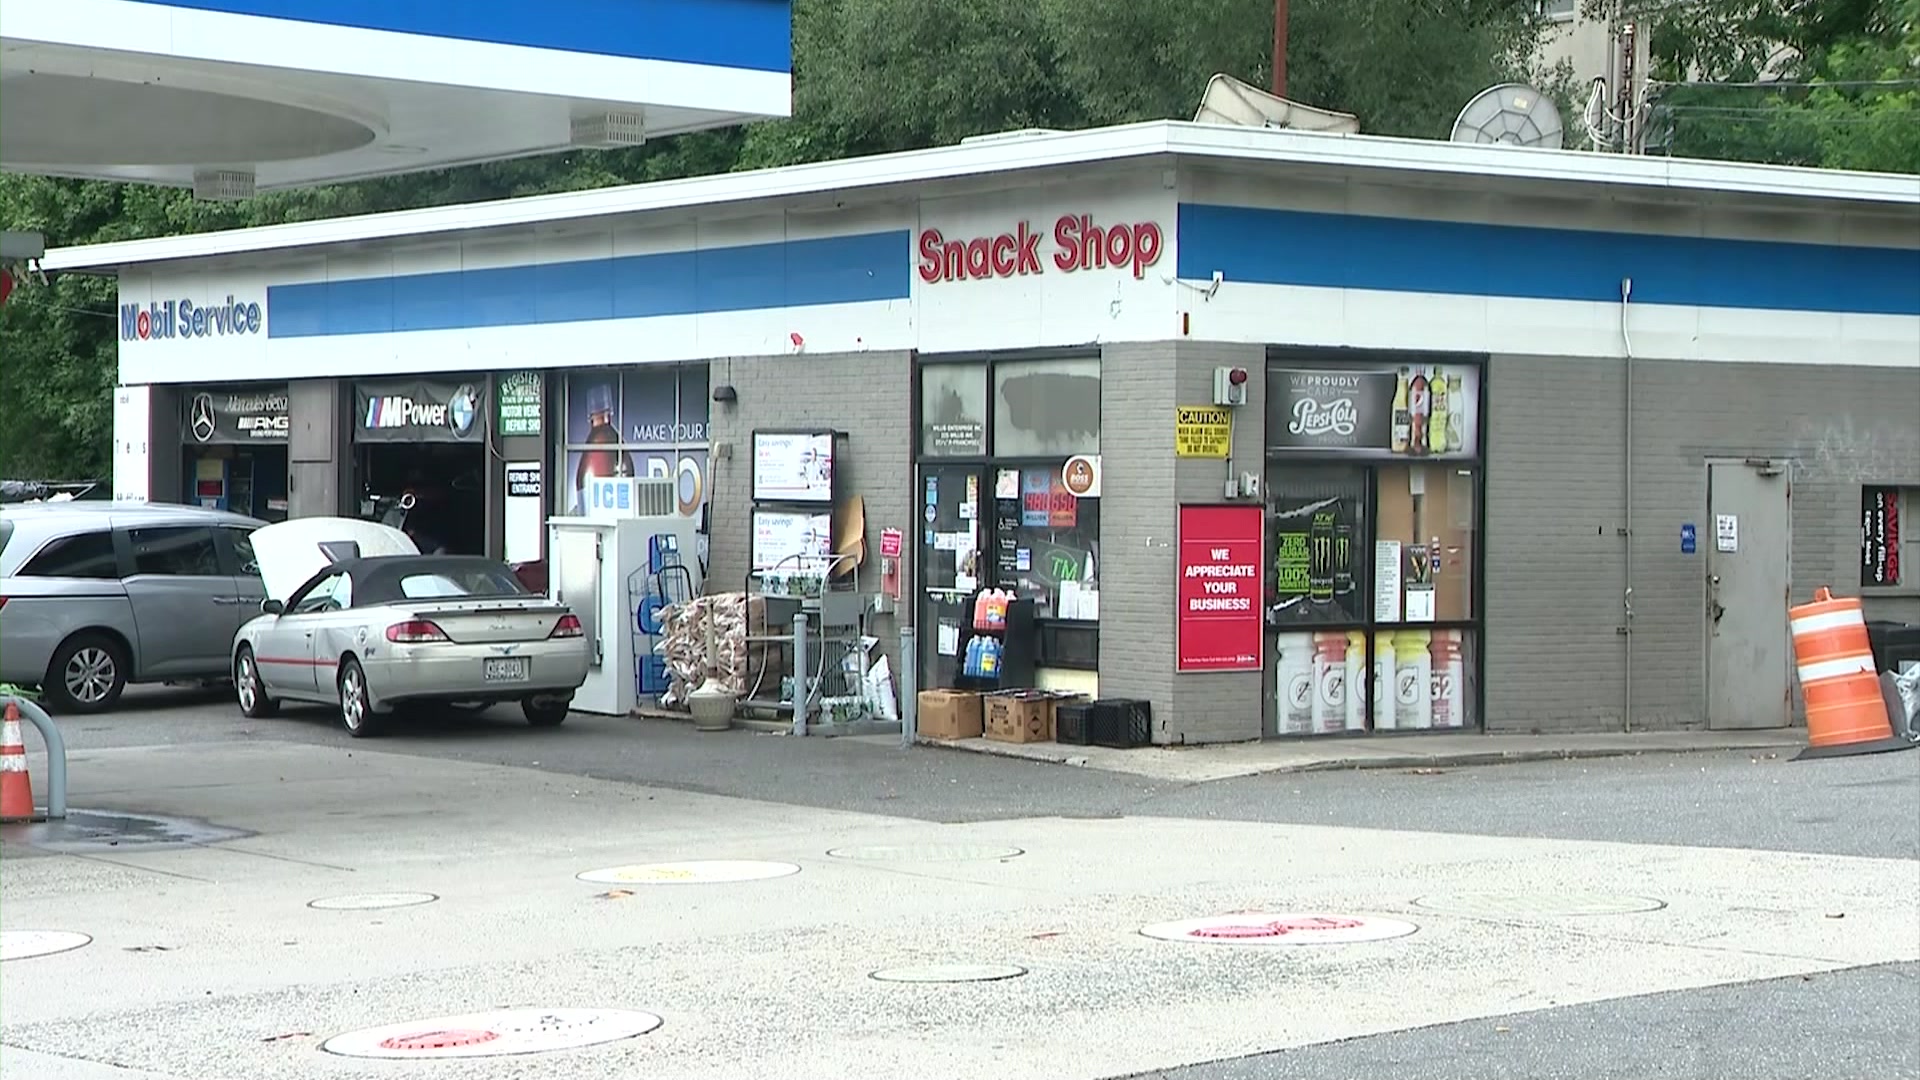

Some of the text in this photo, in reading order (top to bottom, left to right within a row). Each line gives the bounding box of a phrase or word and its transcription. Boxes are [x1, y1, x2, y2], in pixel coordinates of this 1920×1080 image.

[919, 213, 1163, 284] Snack Shop
[121, 294, 262, 341] Mobil Service
[1307, 376, 1360, 387] PROUDLY
[501, 404, 521, 417] MOTOR
[1180, 411, 1226, 424] CAUTION
[505, 419, 527, 432] REPAIR
[633, 423, 703, 440] MAKE YOUR
[509, 472, 528, 482] REPAIR
[594, 482, 630, 509] ICE
[1281, 537, 1307, 547] ZERO
[1874, 492, 1886, 582] on every fill-up
[1887, 492, 1898, 581] SAVINGS
[1210, 548, 1230, 560] WE
[1279, 547, 1310, 556] SUGAR
[1184, 565, 1256, 577] APPRECIATE
[1278, 568, 1310, 580] 100%
[1203, 581, 1238, 594] YOUR
[1189, 598, 1251, 610] BUSINESS!
